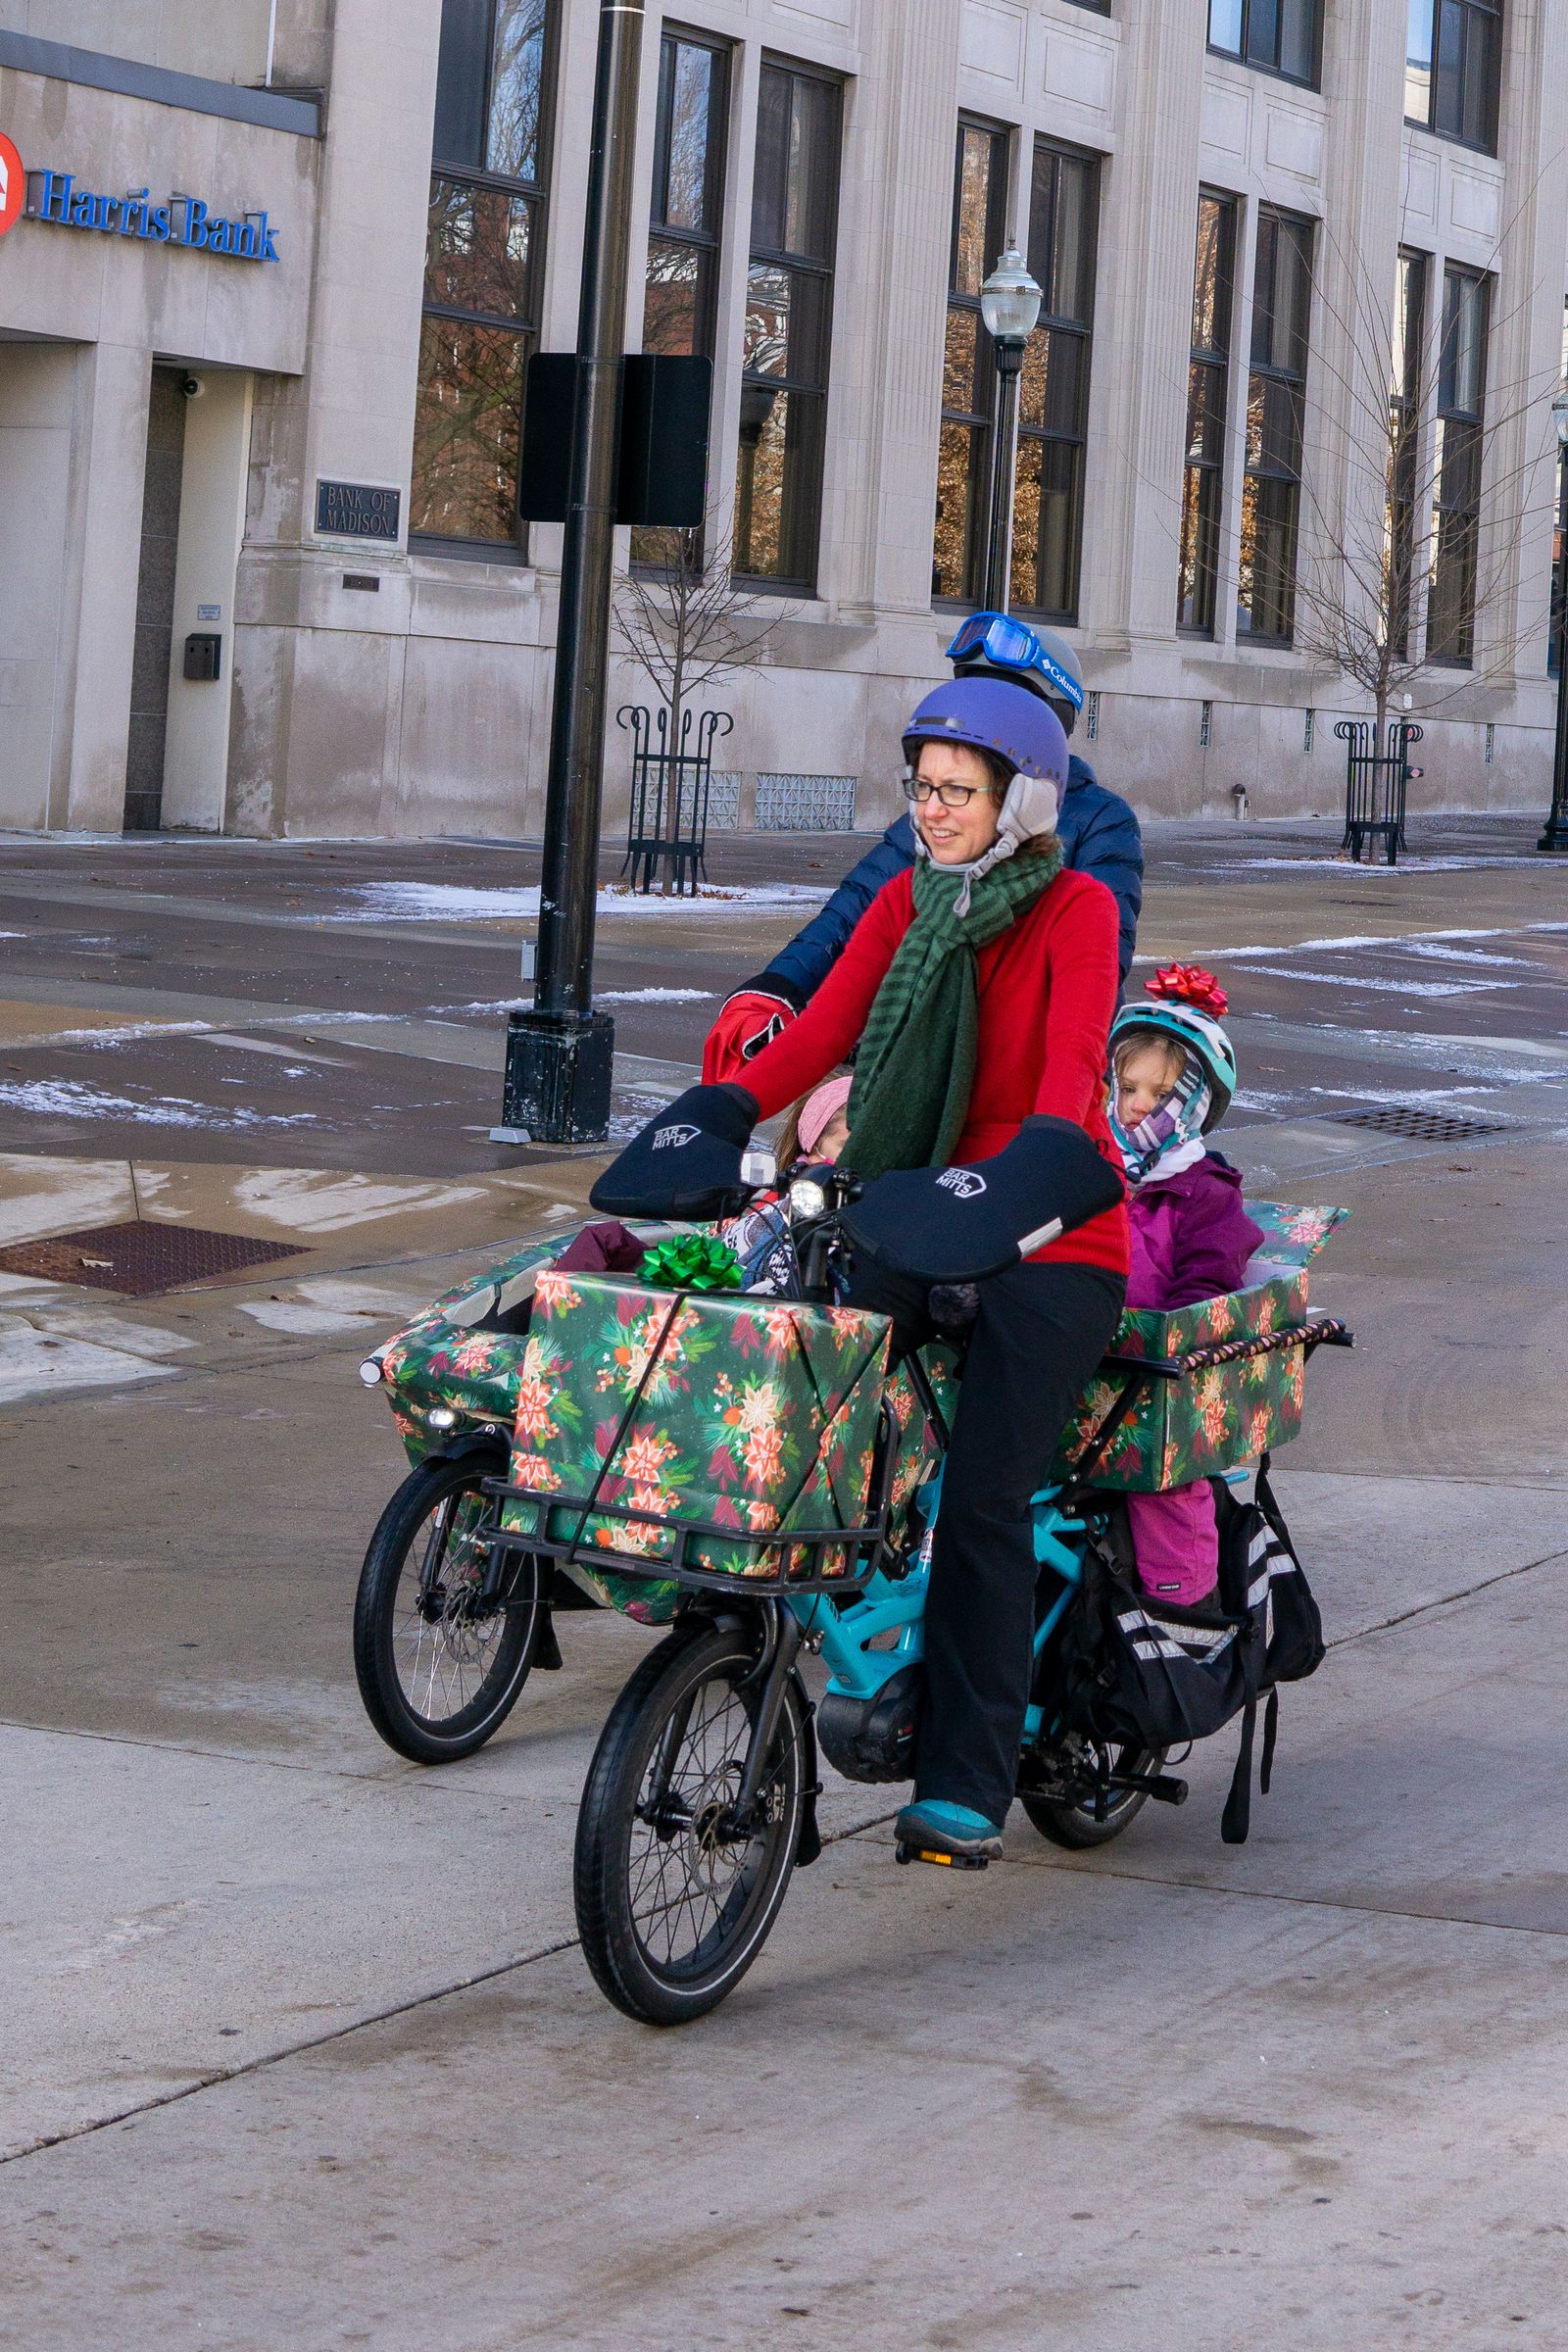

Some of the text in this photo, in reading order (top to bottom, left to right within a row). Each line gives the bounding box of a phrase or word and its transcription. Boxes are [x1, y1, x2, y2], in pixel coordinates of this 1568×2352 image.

[37, 168, 280, 263] Harris Bank
[327, 486, 391, 512] BANK OF
[326, 509, 390, 534] MADISON
[1050, 666, 1082, 704] Columbia
[652, 1133, 687, 1151] MITTS
[655, 1127, 679, 1142] BAR
[935, 1175, 973, 1194] MITTS
[943, 1169, 970, 1183] BAR
